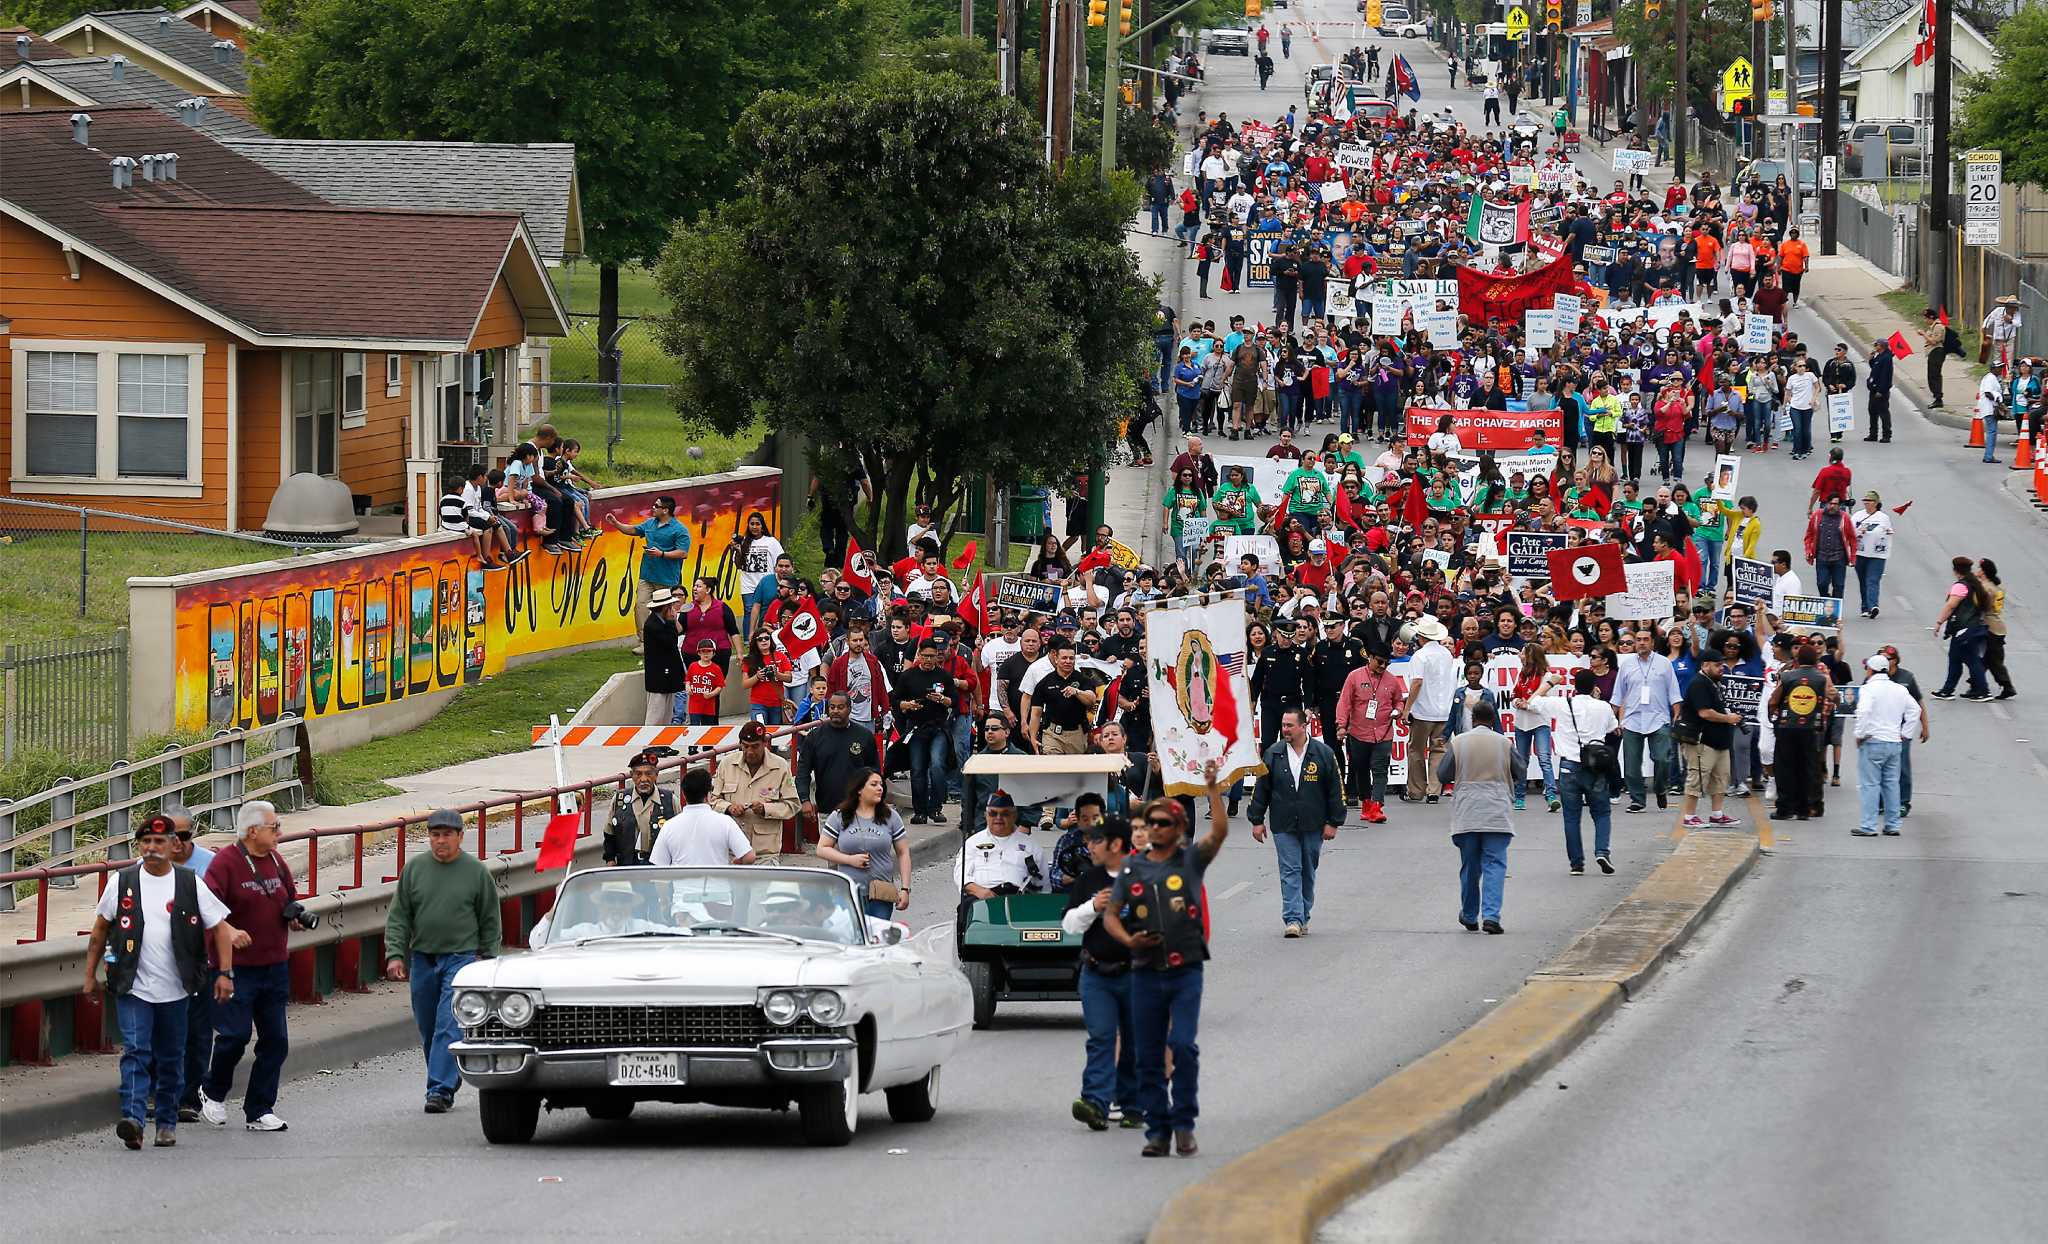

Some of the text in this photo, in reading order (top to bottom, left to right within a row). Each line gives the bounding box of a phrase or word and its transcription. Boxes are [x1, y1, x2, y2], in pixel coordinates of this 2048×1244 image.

[1341, 154, 1370, 167] POWER
[1968, 153, 1999, 161] SCHOOL
[1970, 184, 1997, 201] 20
[1250, 265, 1271, 280] FOR
[1399, 280, 1428, 294] SAM
[1748, 323, 1770, 331] Team,
[1410, 415, 1560, 429] THE CAR CHAVEZ MARCH
[1522, 466, 1546, 474] Justice
[1521, 536, 1541, 547] Pete
[1509, 542, 1563, 556] GALLE
[1514, 557, 1548, 567] For Cong
[1743, 562, 1758, 574] Pete
[1736, 567, 1773, 587] GALLEGO
[1003, 582, 1044, 601] SALAZAR
[1001, 594, 1013, 602] FOR
[1783, 599, 1824, 615] SALAZAR
[1784, 611, 1794, 620] FOR
[206, 556, 487, 730] BIENVENIDOS
[1727, 679, 1747, 689] Pete
[1724, 690, 1761, 700] ALLEG
